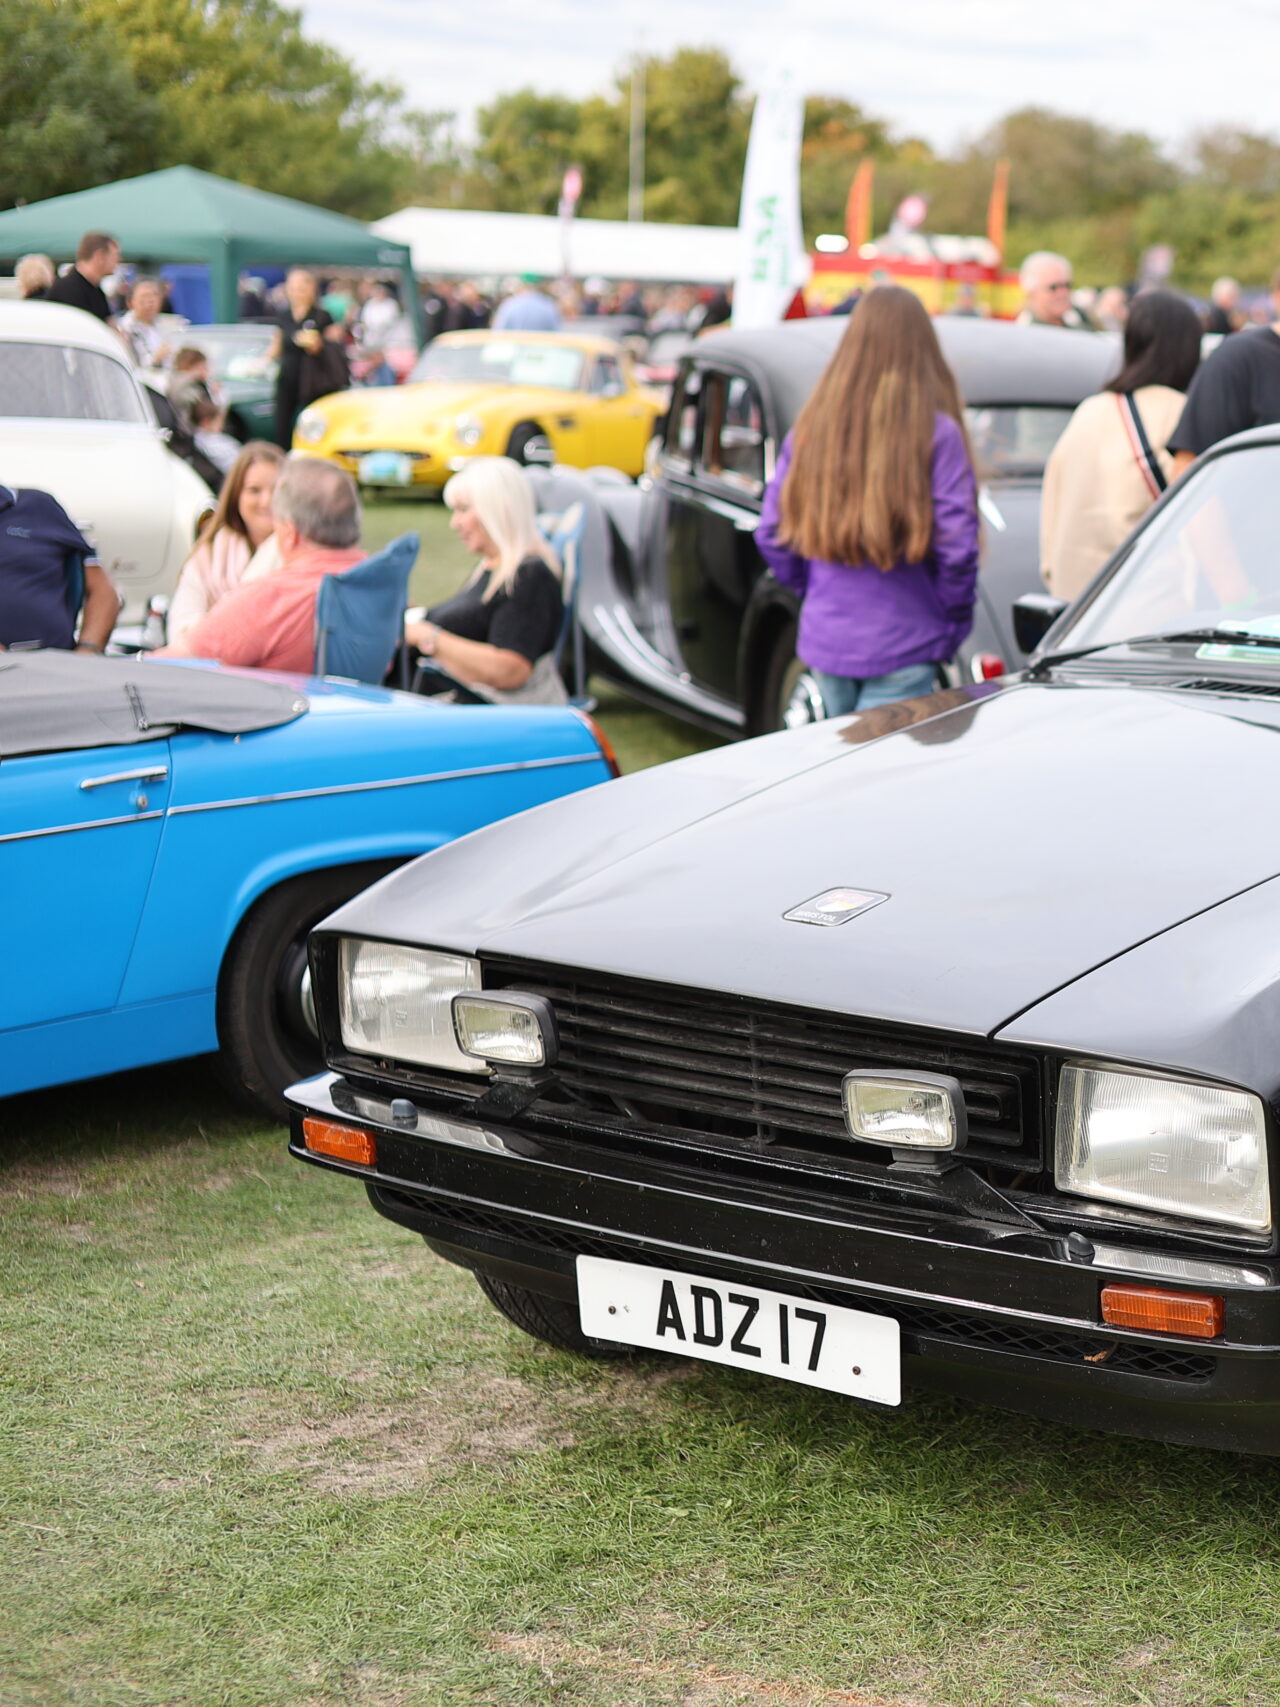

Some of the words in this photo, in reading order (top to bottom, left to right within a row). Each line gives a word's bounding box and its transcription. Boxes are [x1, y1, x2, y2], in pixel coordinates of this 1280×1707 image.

[794, 910, 837, 922] BRISTOL
[656, 1279, 762, 1358] ADZ
[779, 1303, 827, 1372] 17
